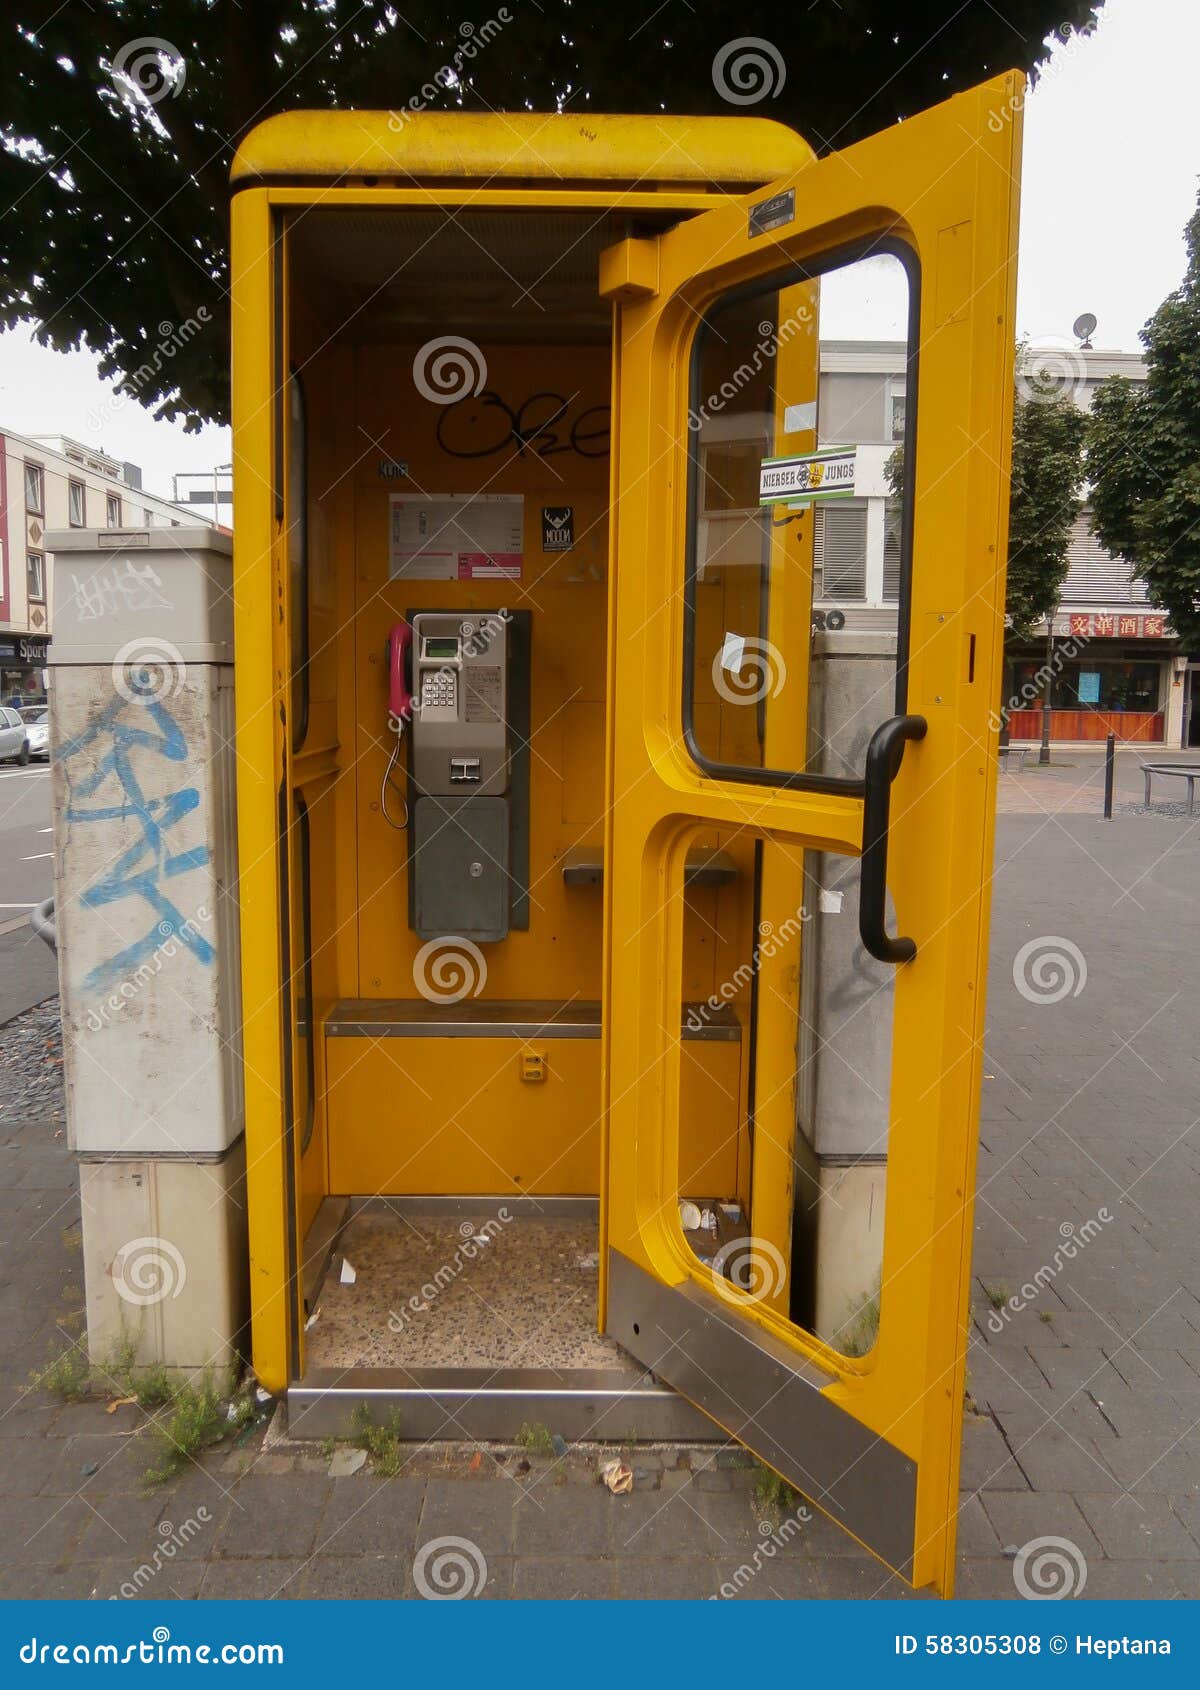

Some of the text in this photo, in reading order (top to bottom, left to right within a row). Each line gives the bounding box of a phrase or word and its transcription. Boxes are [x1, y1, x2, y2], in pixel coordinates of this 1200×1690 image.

[825, 463, 854, 480] JUNGS
[1071, 616, 1162, 635] 文華酒家
